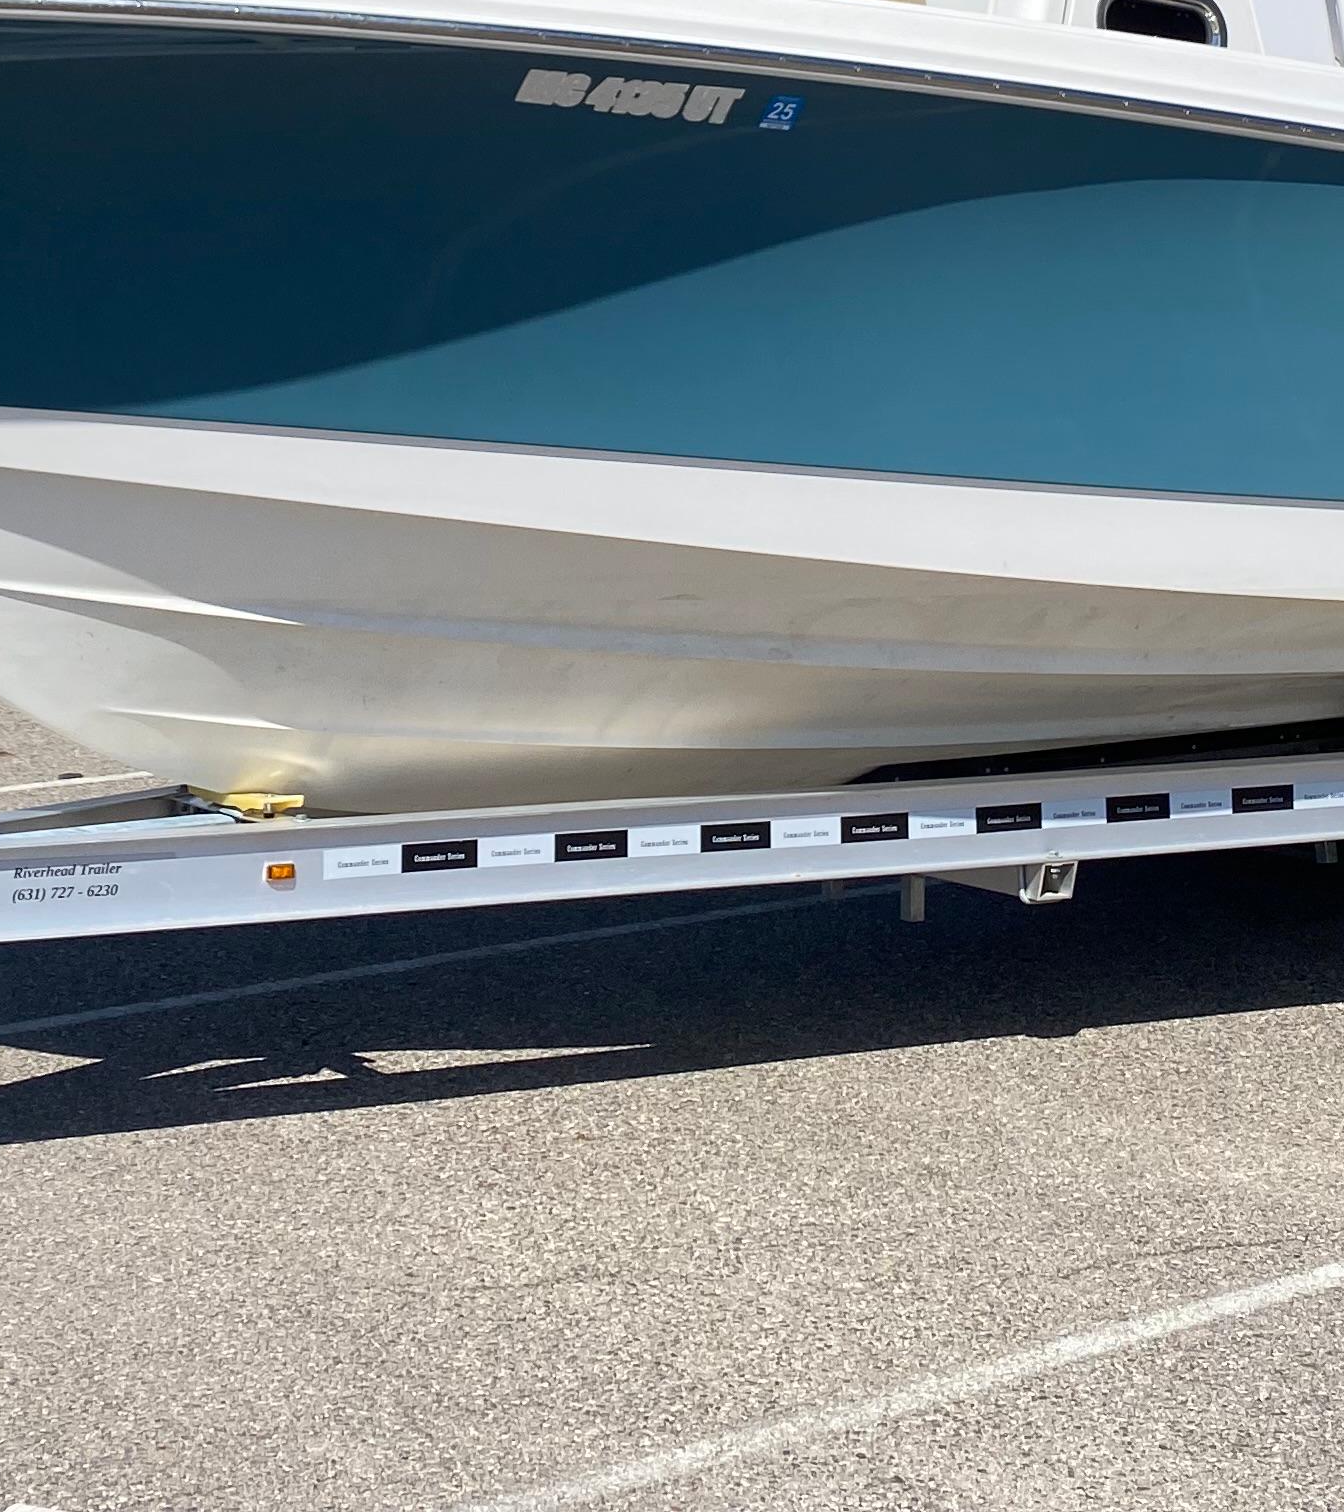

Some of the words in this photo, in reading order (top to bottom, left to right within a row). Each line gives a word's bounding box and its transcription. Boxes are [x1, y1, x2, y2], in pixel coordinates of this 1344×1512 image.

[767, 101, 797, 120] 25
[14, 864, 76, 879] Riverhead
[81, 862, 123, 876] Trailer
[12, 888, 46, 904] (631)
[50, 886, 75, 899] 727
[86, 884, 119, 897] 6230
